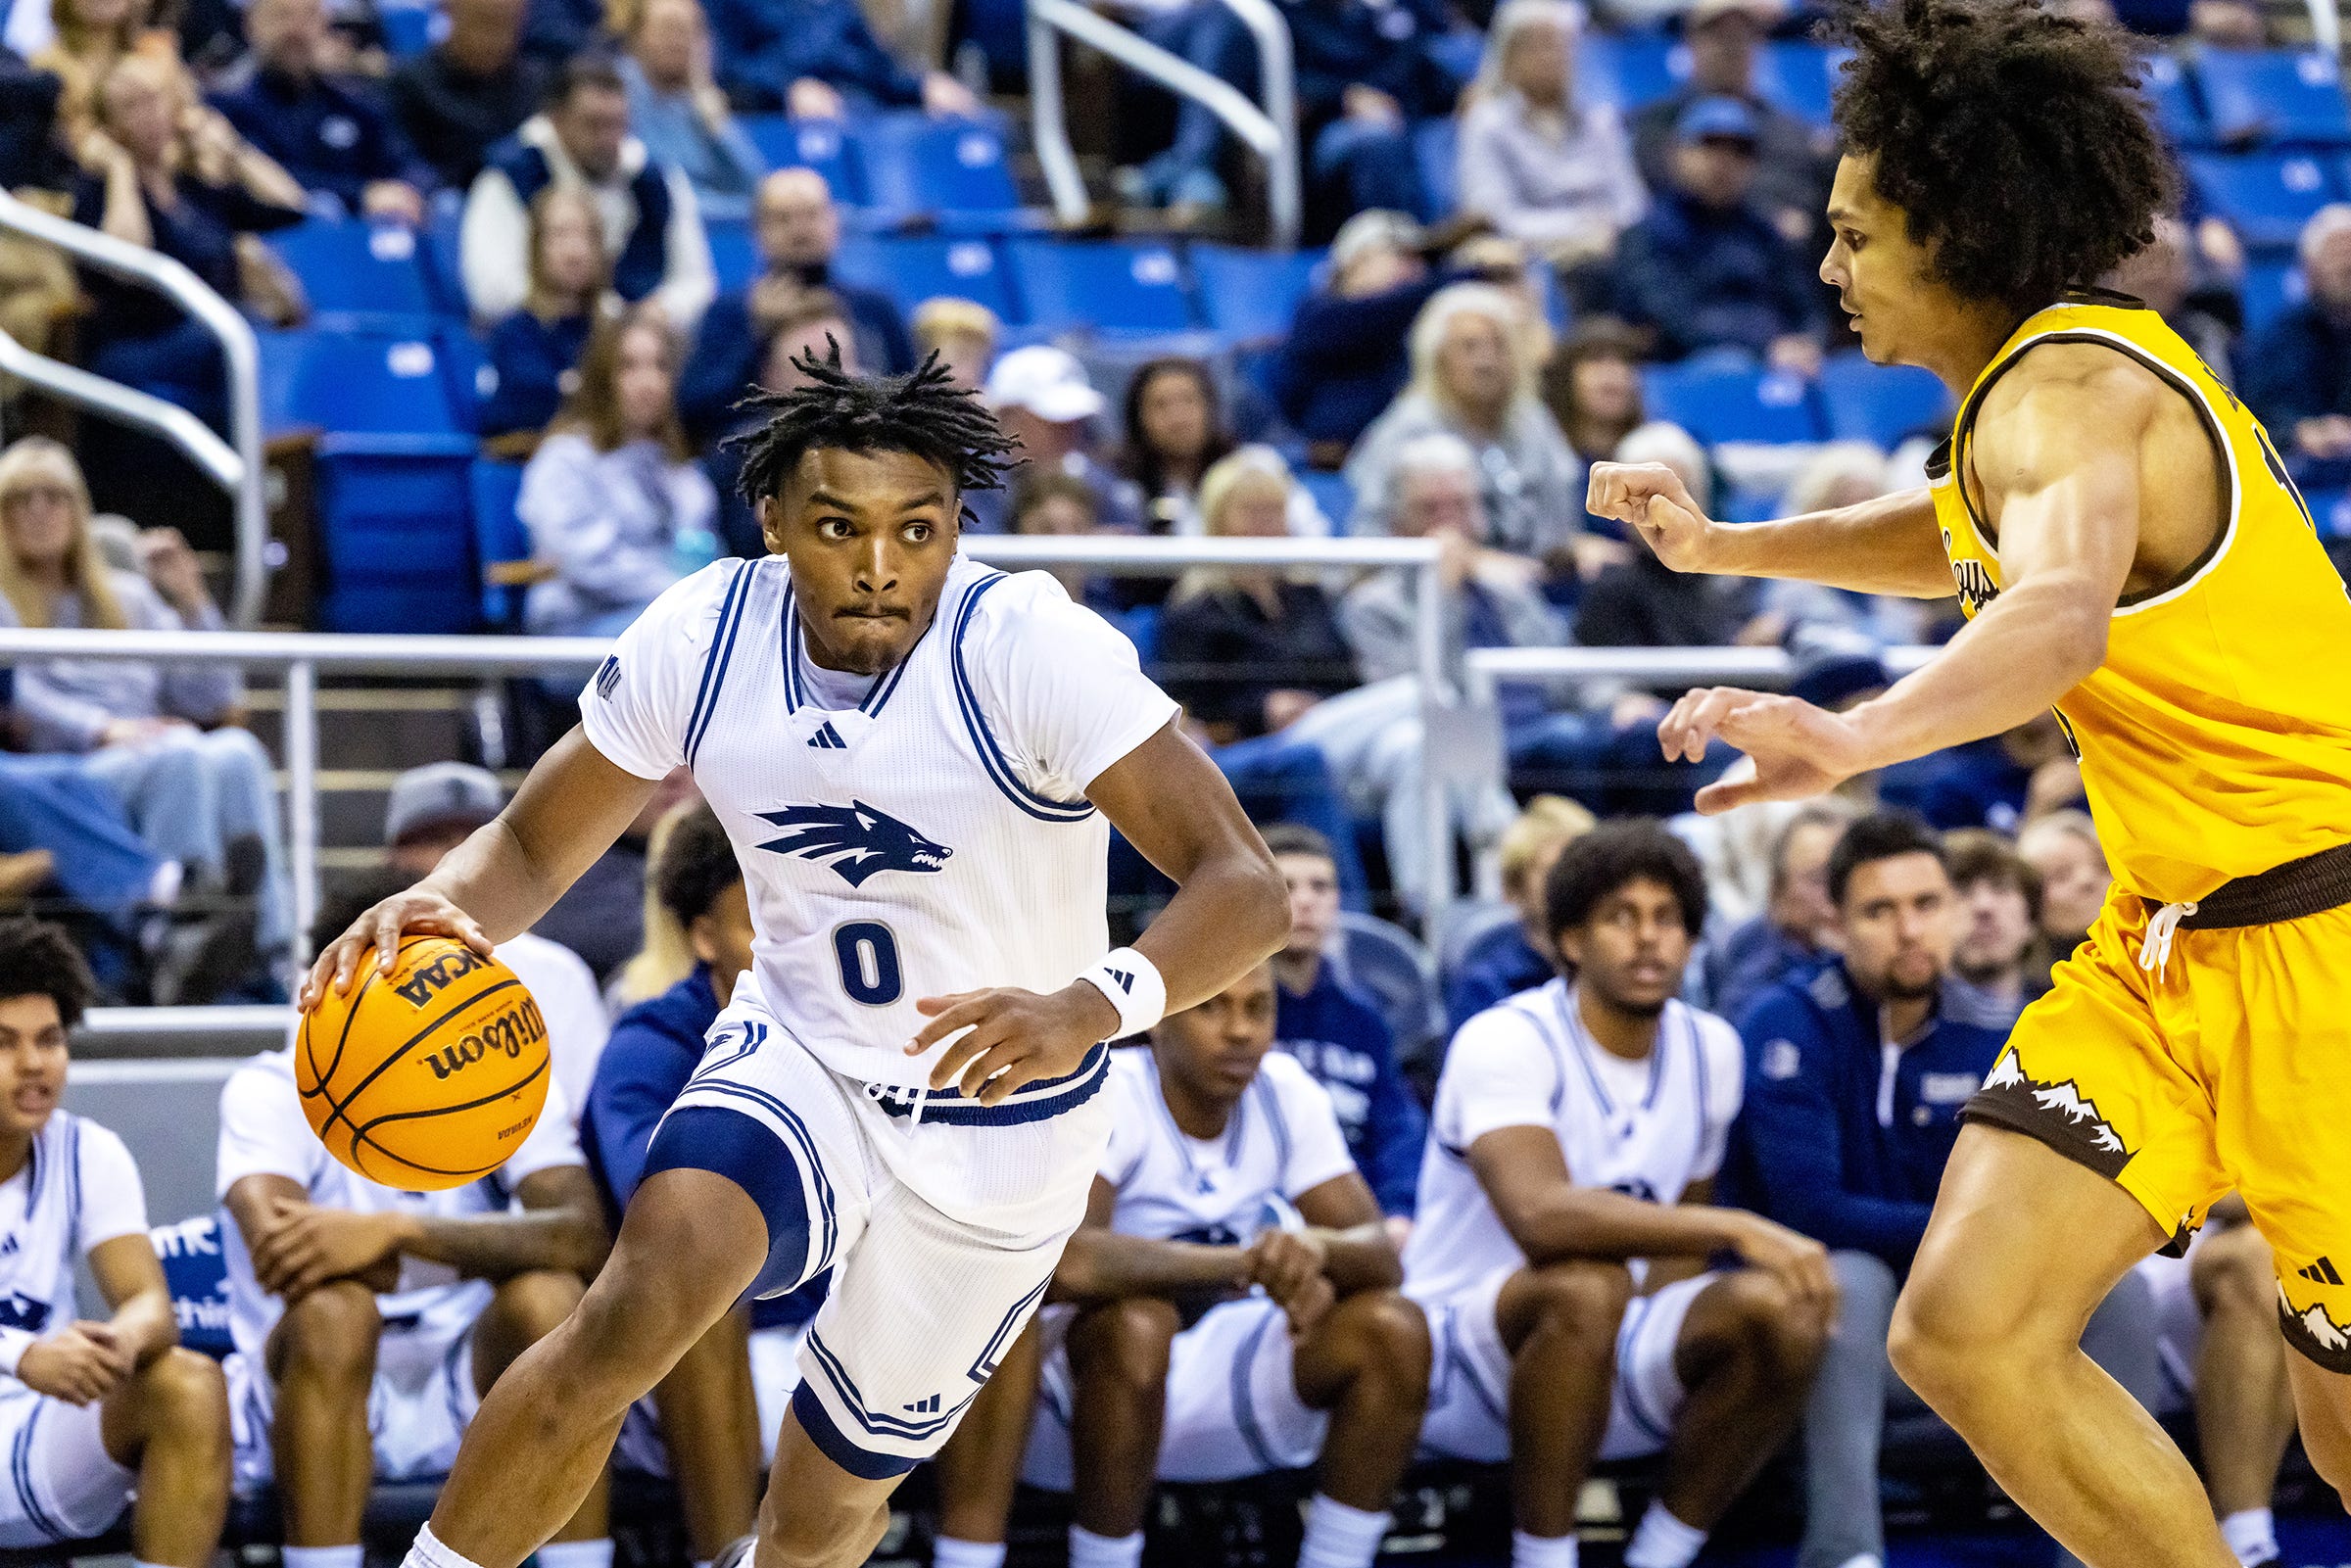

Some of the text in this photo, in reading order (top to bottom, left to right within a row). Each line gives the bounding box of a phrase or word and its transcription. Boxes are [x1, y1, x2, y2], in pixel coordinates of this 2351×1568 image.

[394, 948, 494, 1008] NCAA
[831, 919, 905, 1009] 0
[423, 996, 547, 1080] Wilson
[498, 1115, 533, 1140] NEVADA
